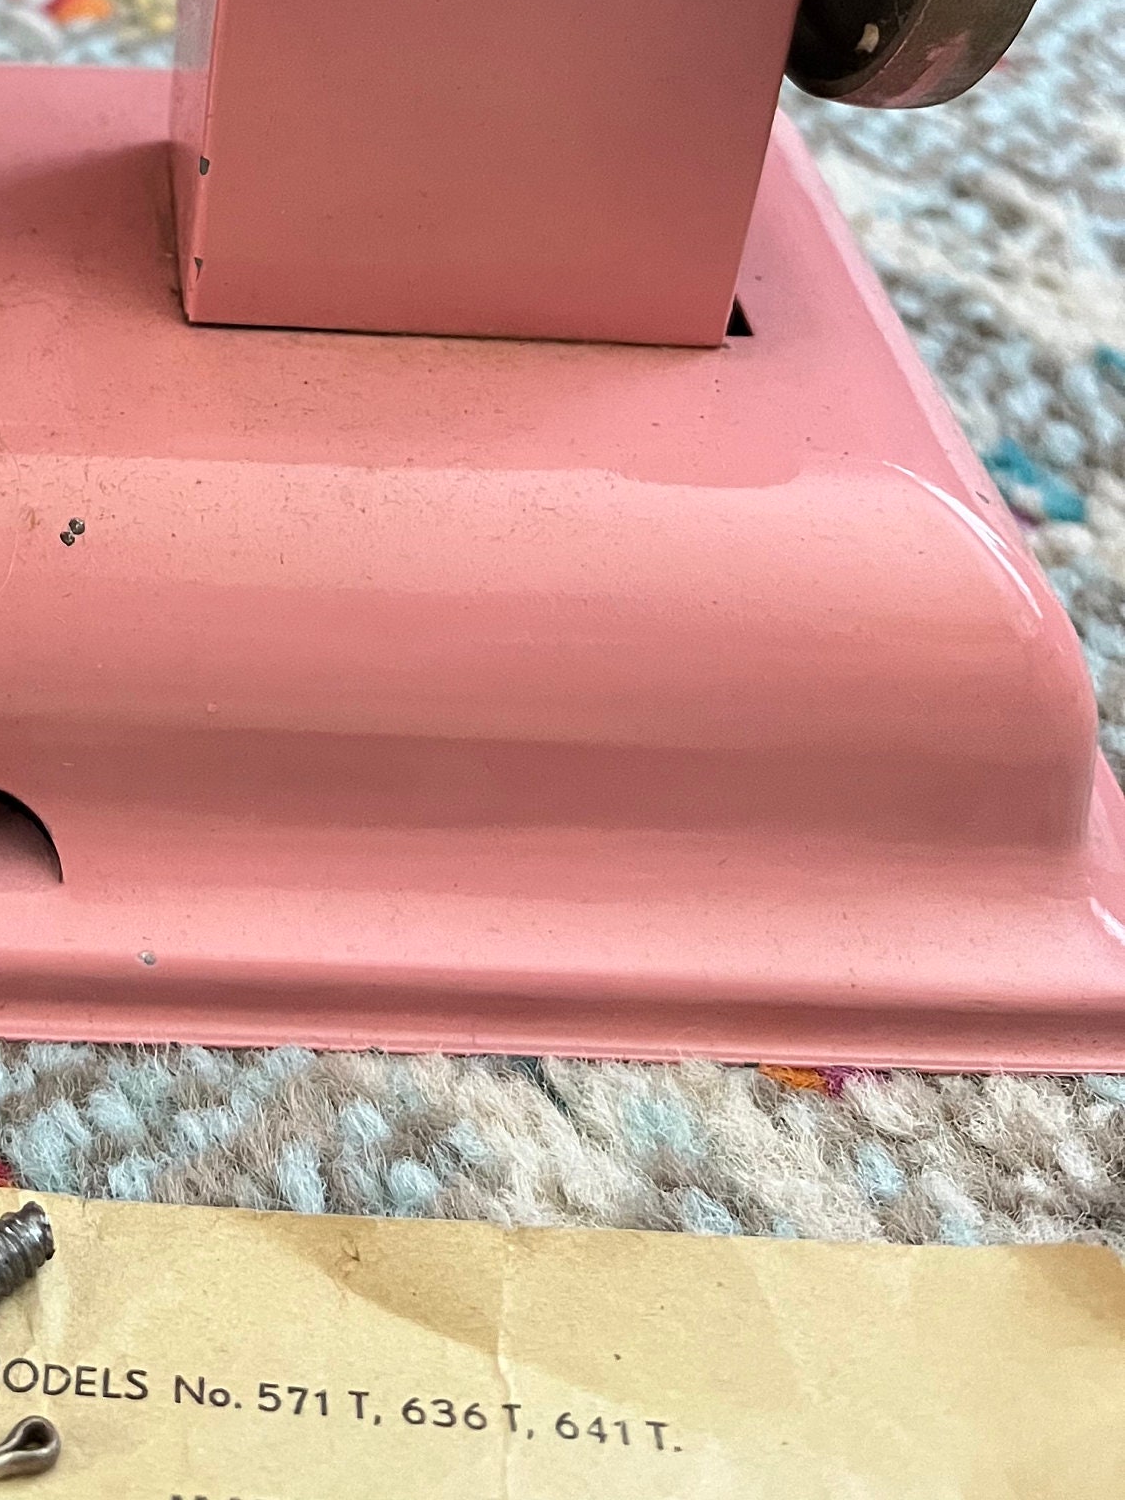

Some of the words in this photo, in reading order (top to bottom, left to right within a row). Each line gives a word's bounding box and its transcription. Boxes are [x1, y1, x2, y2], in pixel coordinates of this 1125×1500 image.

[174, 1375, 243, 1411] No.
[257, 1383, 330, 1417] 571
[347, 1390, 382, 1426] T,
[401, 1398, 488, 1431] 636
[499, 1403, 535, 1439] T,
[555, 1411, 630, 1446] 641
[644, 1420, 684, 1453] T.
